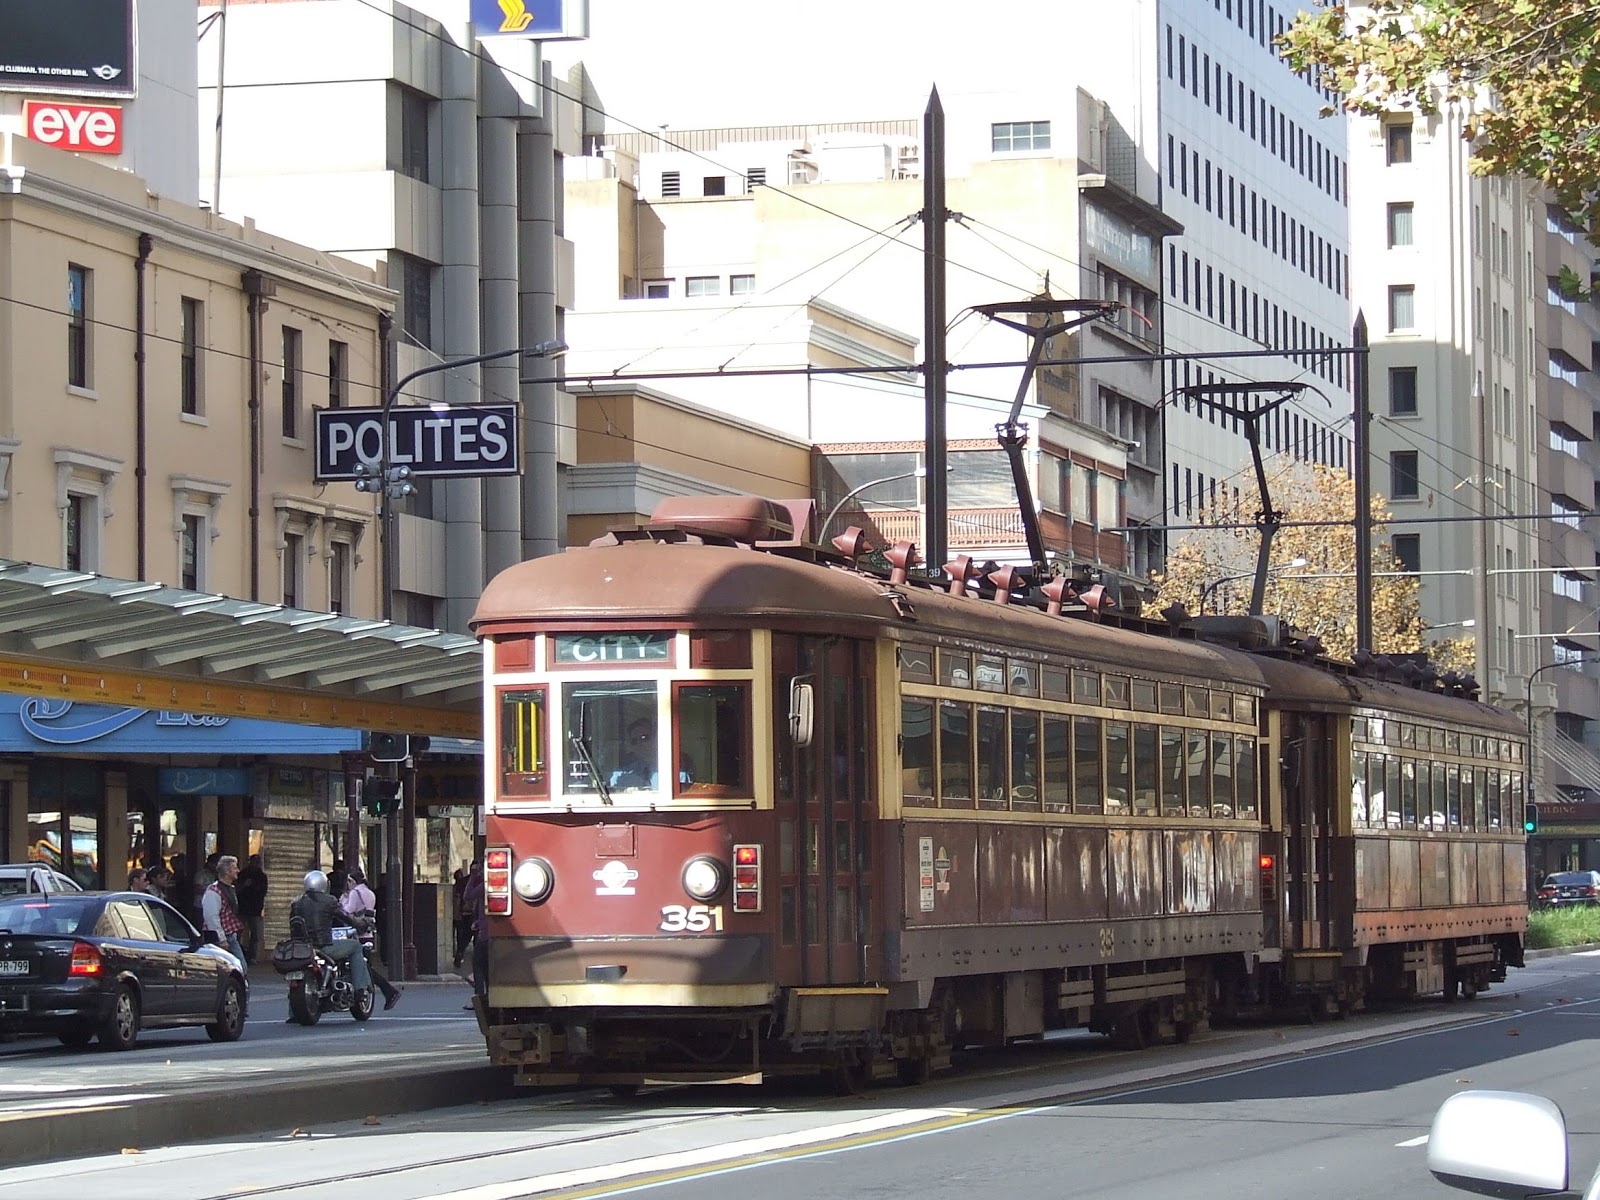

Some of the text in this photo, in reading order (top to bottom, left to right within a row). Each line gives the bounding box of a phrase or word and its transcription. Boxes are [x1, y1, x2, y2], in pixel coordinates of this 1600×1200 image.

[38, 67, 50, 75] THE
[51, 68, 71, 76] OTHER
[33, 108, 116, 147] eye
[329, 415, 508, 466] POLITES
[928, 567, 941, 579] 39
[572, 634, 654, 662] CITY
[659, 904, 723, 932] 351
[14, 961, 28, 971] 799
